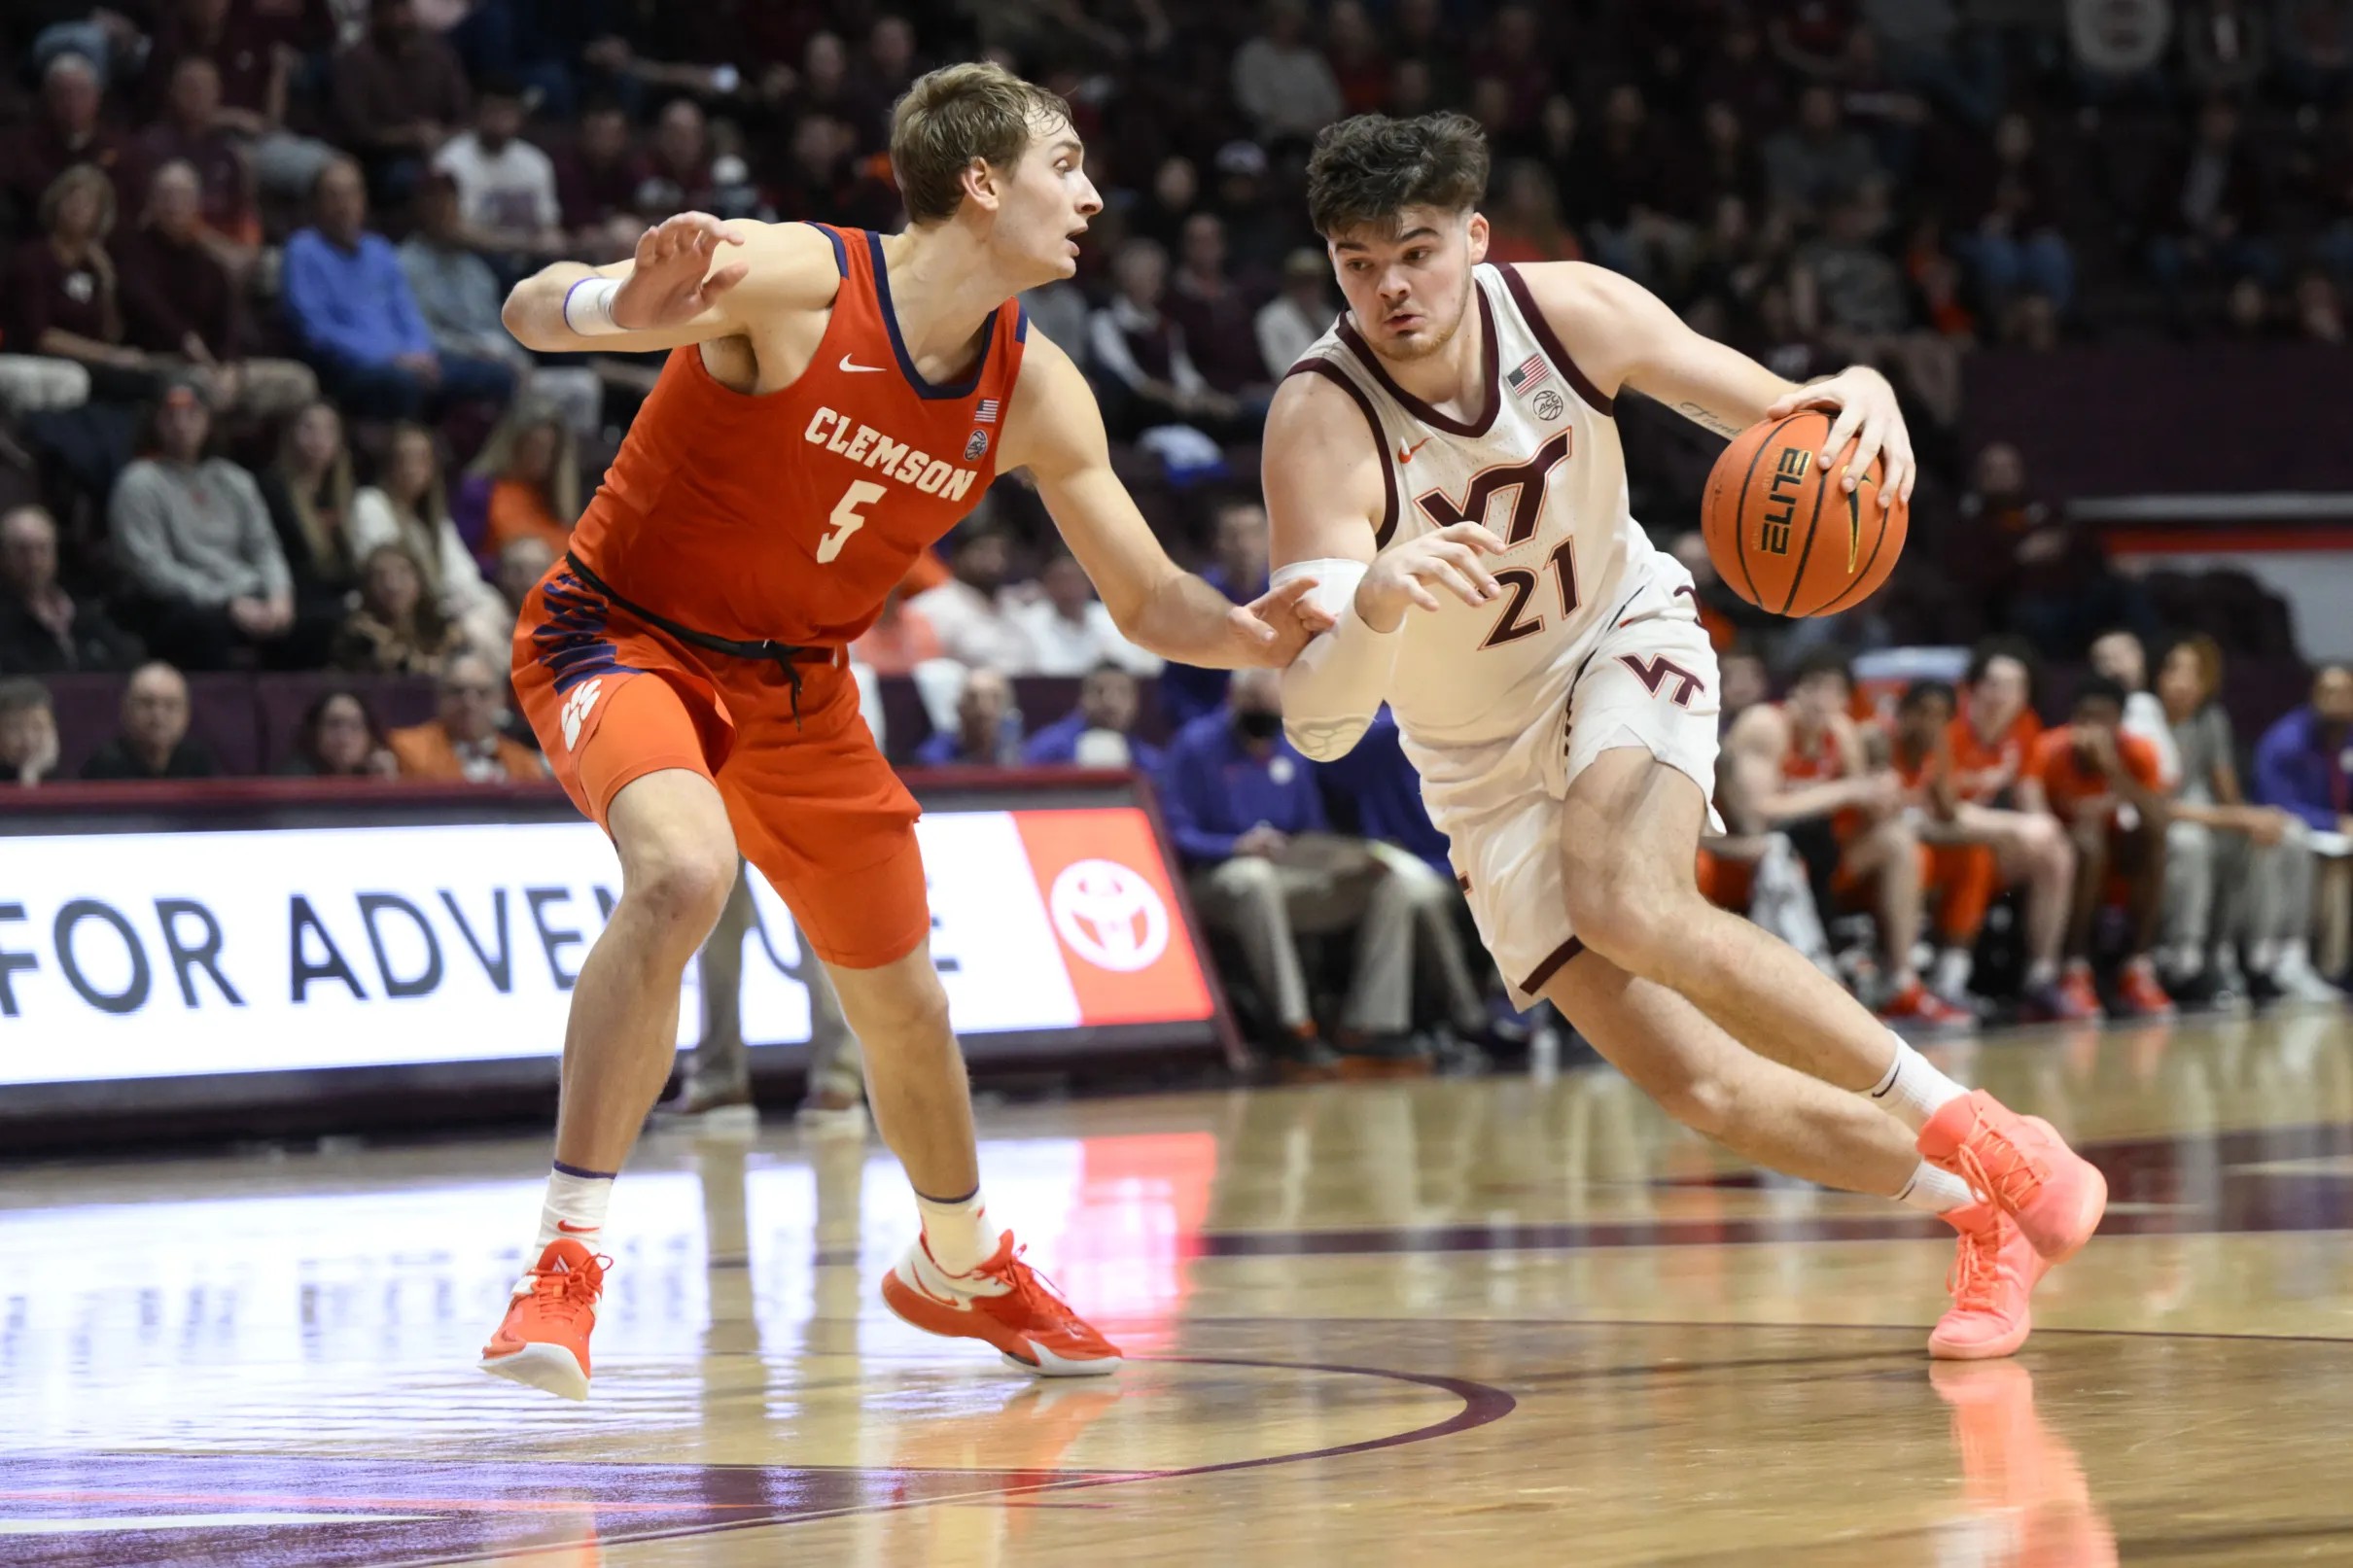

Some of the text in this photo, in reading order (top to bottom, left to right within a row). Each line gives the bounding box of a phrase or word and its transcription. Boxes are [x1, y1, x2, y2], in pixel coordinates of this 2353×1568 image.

[805, 406, 977, 502] CLEMSON
[1413, 426, 1572, 550] VT
[1761, 447, 1812, 556] ELITE
[817, 479, 887, 564] 5
[1475, 535, 1582, 651] 21
[1613, 652, 1706, 709] VT
[0, 898, 246, 1018] FOR
